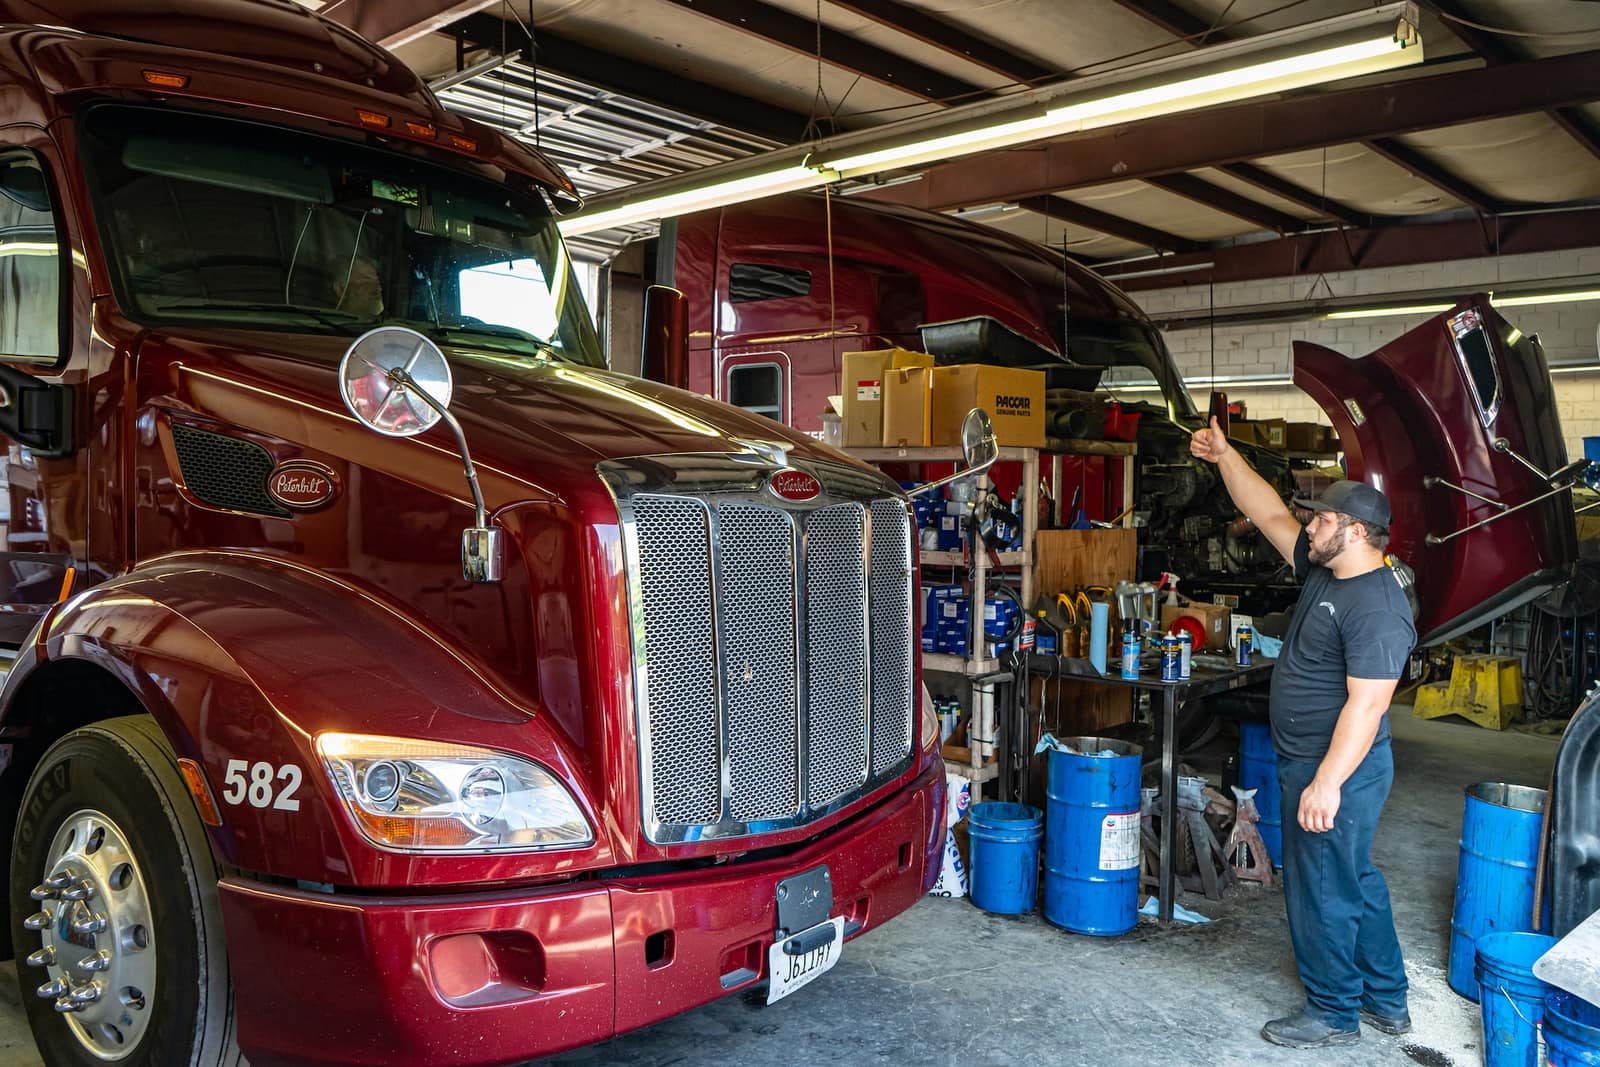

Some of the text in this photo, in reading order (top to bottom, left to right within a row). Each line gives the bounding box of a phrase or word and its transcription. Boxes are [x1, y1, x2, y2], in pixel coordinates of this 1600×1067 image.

[996, 395, 1030, 408] PACCAR
[277, 474, 324, 493] Peterbilt
[222, 759, 303, 812] 582
